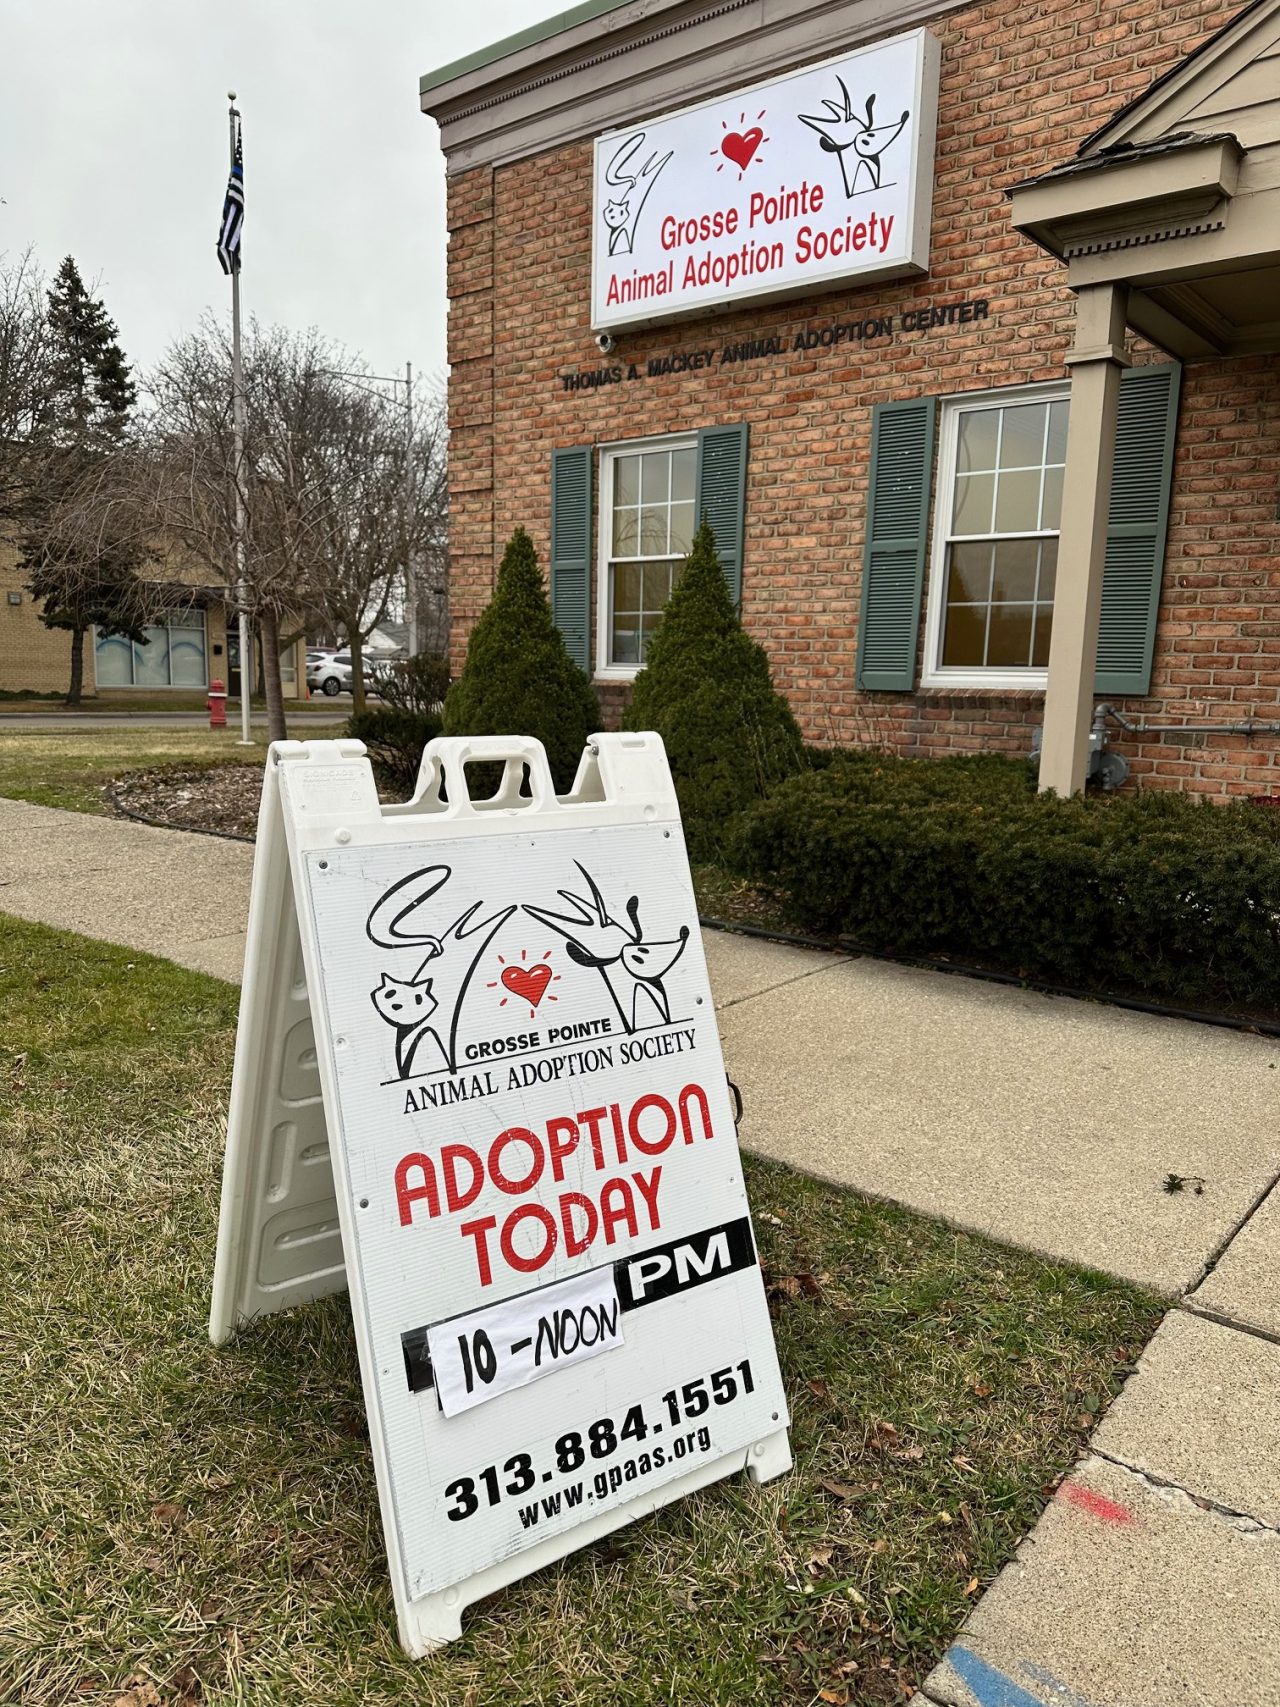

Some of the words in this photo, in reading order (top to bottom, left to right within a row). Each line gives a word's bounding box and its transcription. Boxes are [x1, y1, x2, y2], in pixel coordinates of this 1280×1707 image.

[606, 261, 674, 306] Animal
[682, 241, 784, 289] Adoption
[795, 212, 895, 264] Society
[661, 207, 738, 250] Grosse
[749, 181, 824, 228] Pointe
[561, 366, 622, 391] THOMAS
[627, 363, 642, 380] A.
[648, 349, 715, 377] MACKEY
[720, 335, 786, 364] ANIMAL
[793, 316, 893, 351] ADOPTION
[901, 299, 989, 332] CENTER
[403, 1072, 499, 1114] ANIMAL
[506, 1046, 614, 1091] ADOPTION
[620, 1028, 698, 1065] SOCIETY
[465, 1032, 540, 1061] GROSSE
[548, 1018, 612, 1044] POINTE
[394, 1083, 714, 1227] ADOPTION
[460, 1165, 663, 1287] TODAY
[628, 1231, 732, 1300] PM
[457, 1328, 498, 1394] 10
[444, 1359, 755, 1522] 313.884.1551
[518, 1426, 711, 1529] www.gpaas.org
